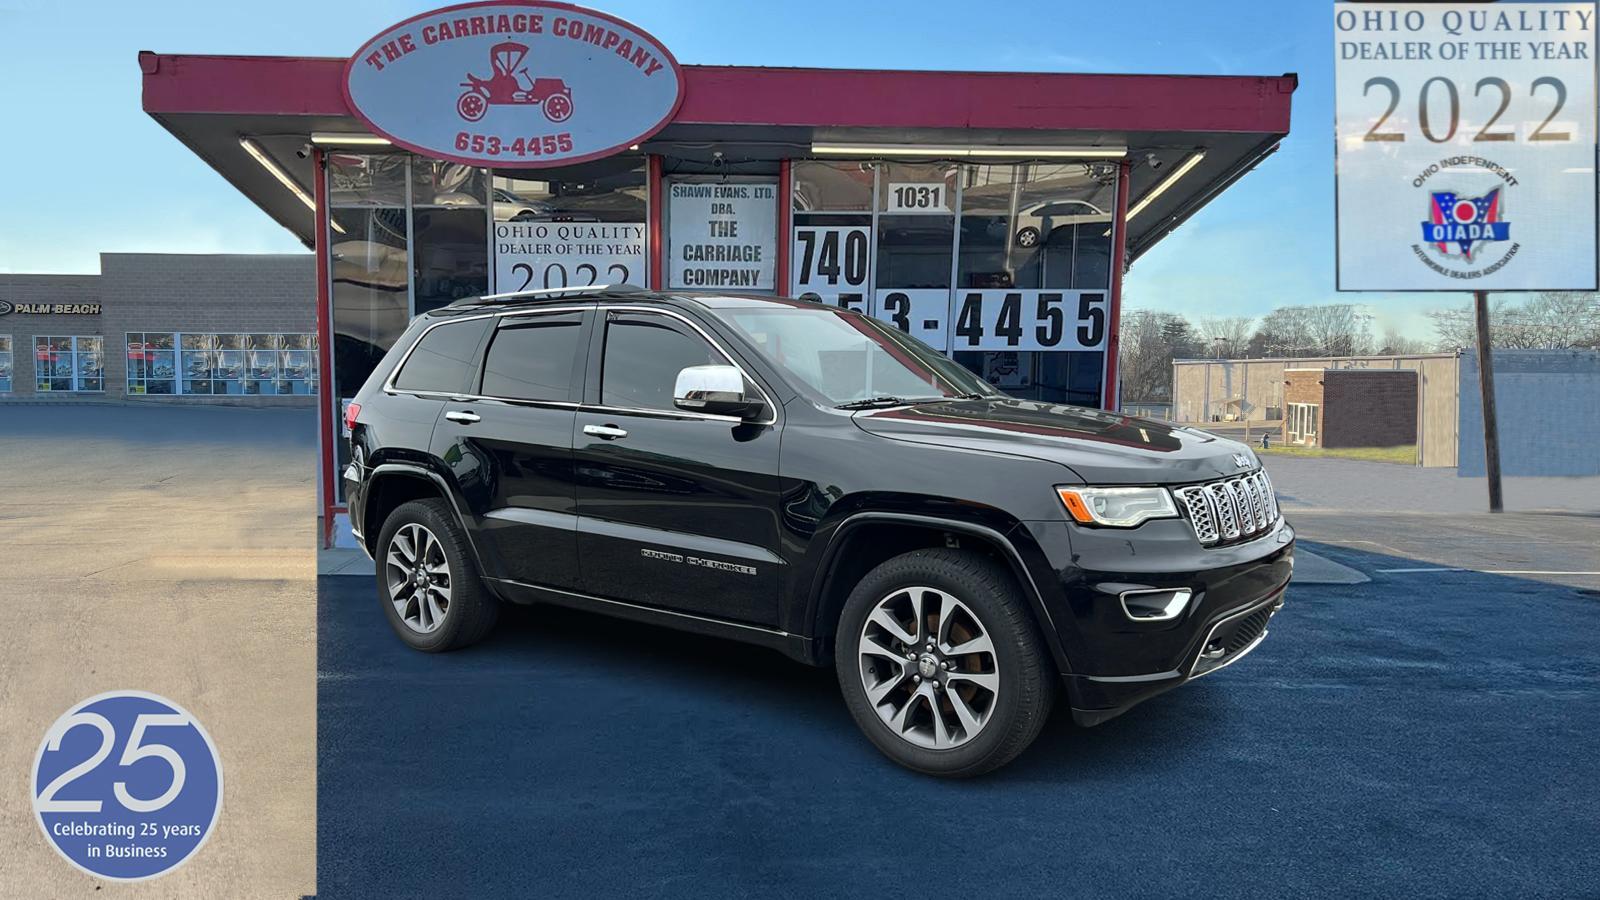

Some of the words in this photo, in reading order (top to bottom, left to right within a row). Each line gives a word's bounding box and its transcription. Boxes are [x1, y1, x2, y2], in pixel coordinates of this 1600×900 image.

[1336, 10, 1425, 31] OHIO
[1442, 10, 1593, 35] QUALITY
[365, 33, 417, 71] THE
[422, 14, 544, 46] CARRIAGE
[552, 16, 664, 77] COMPANY
[1340, 41, 1433, 60] DEALER
[1439, 41, 1469, 60] OF
[1475, 41, 1522, 60] THE
[1528, 41, 1589, 60] YEAR
[1363, 76, 1571, 143] 2022
[454, 131, 574, 157] 653-4455
[1412, 163, 1439, 188] OHIO
[1440, 155, 1519, 187] INDEPENDENT
[672, 185, 712, 199] SHAWN
[754, 186, 775, 200] LTD.
[894, 187, 940, 208] 1031
[496, 225, 549, 239] OHIO
[558, 225, 645, 241] QUALITY
[708, 220, 738, 238] THE
[1432, 224, 1495, 240] OIADA
[499, 243, 551, 255] DEALER
[555, 243, 574, 255] OF
[576, 243, 603, 255] THE
[606, 243, 641, 255] YEAR
[683, 244, 762, 262] CARRIAGE
[797, 229, 868, 286] 740
[683, 268, 760, 286] COMPANY
[1450, 270, 1482, 279] DEALERS
[15, 303, 51, 314] PALM
